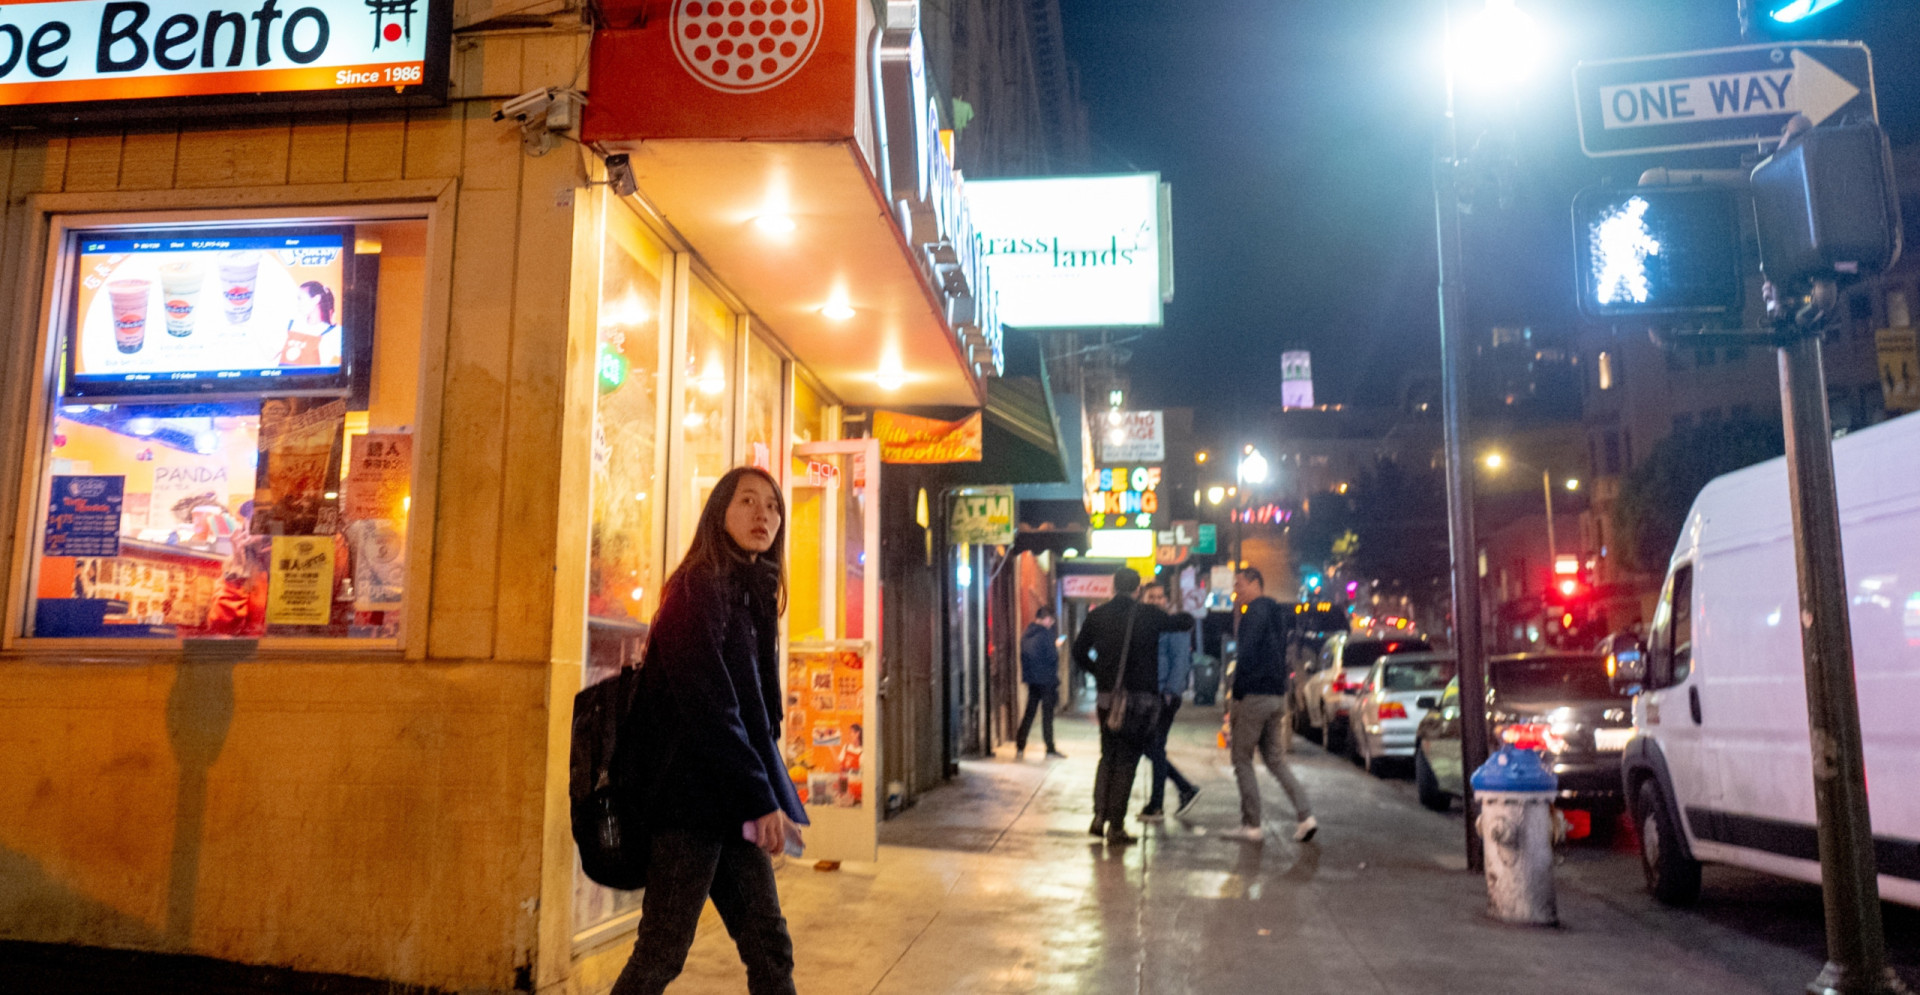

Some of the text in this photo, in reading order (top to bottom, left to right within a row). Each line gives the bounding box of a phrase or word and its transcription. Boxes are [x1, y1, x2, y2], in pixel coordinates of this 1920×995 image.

[97, 0, 330, 74] Bento
[335, 66, 421, 85] Since 1986
[1612, 73, 1793, 123] ONE WAY
[155, 466, 228, 483] PANDA
[1131, 467, 1162, 492] OF
[951, 497, 1010, 523] ATM
